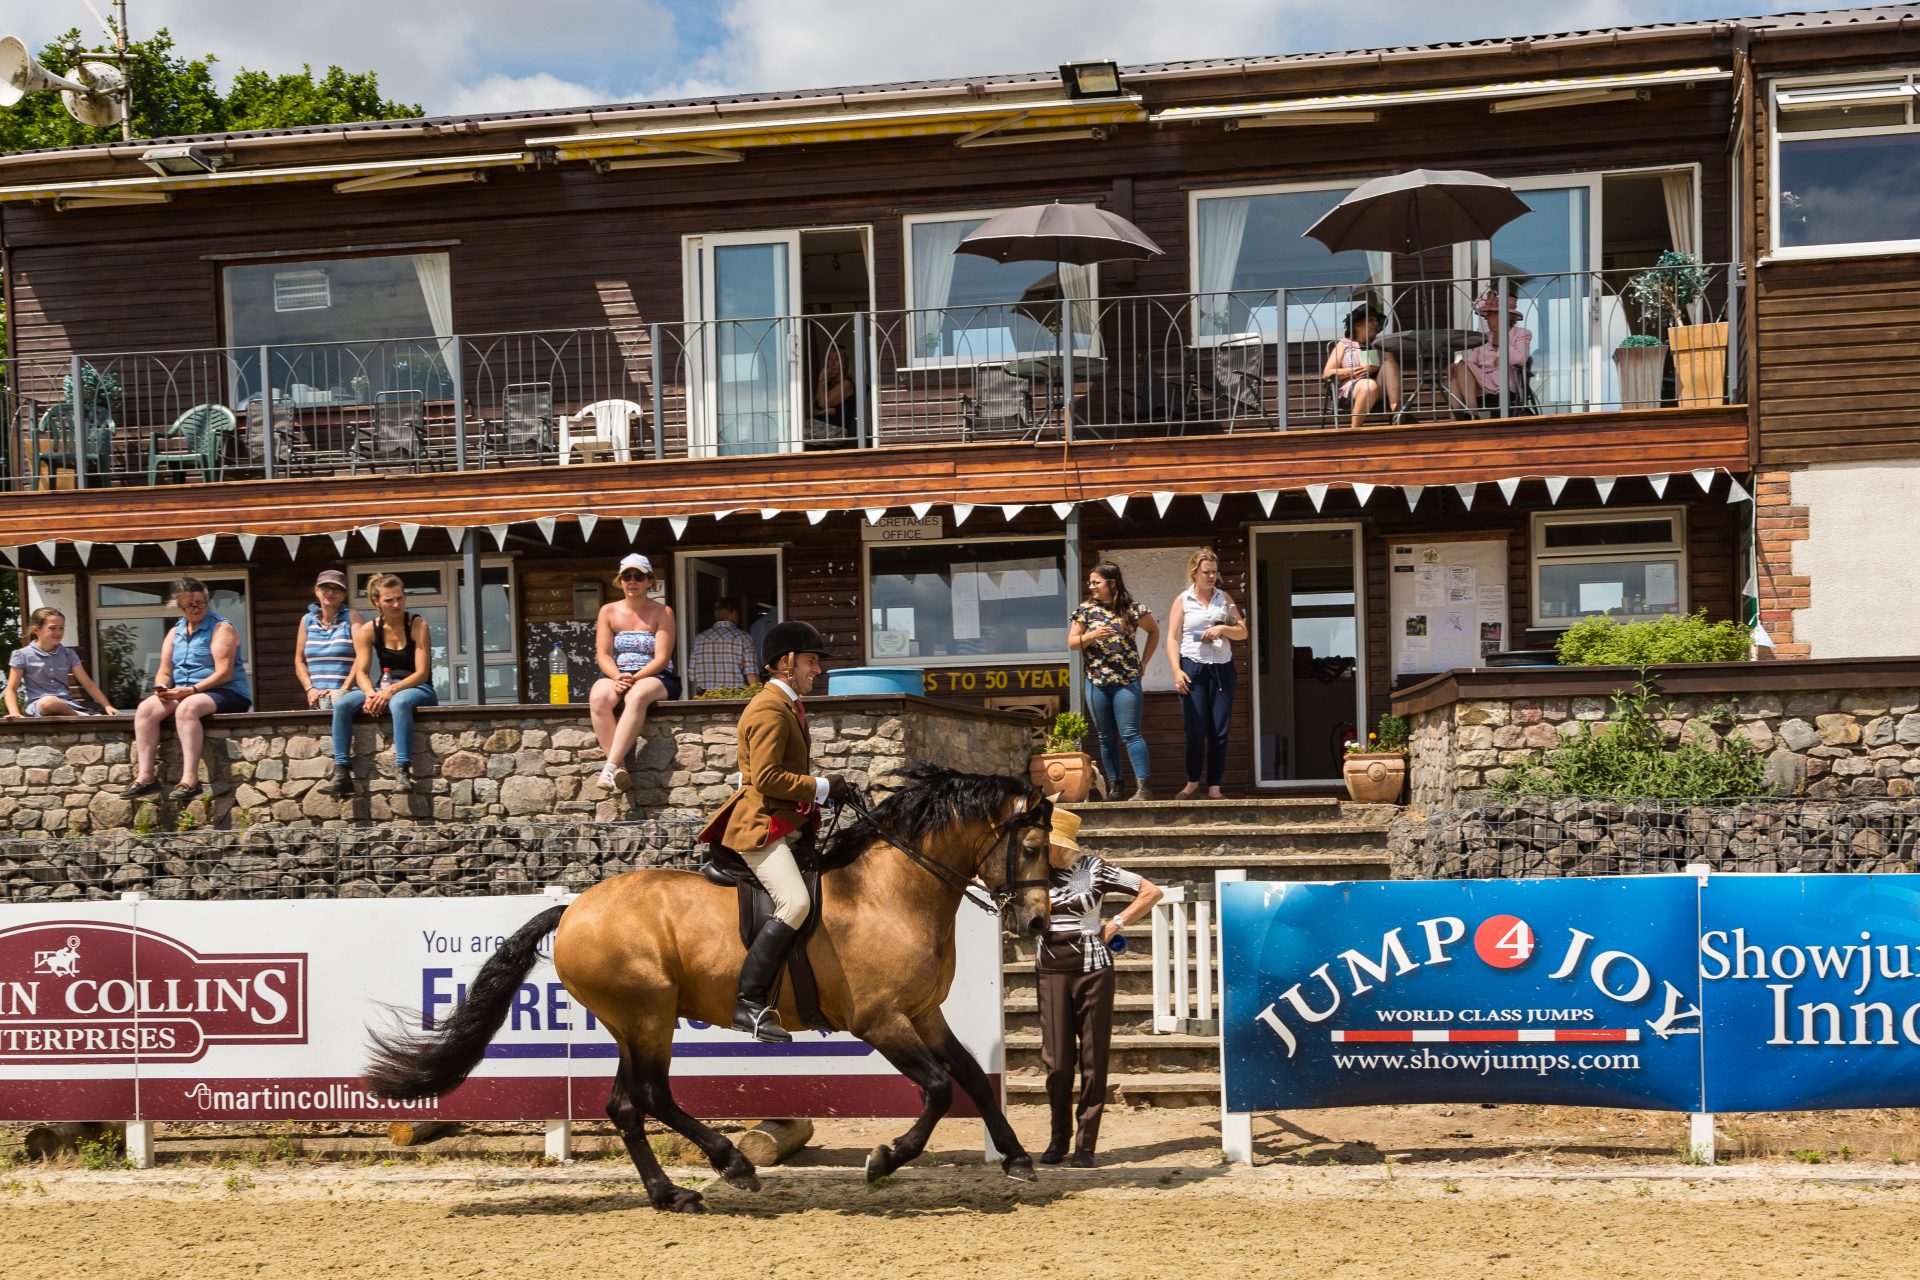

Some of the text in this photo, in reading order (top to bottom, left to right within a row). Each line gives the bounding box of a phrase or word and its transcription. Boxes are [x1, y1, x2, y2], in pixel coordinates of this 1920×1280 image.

[864, 517, 939, 528] SCRETARIES
[882, 530, 921, 540] OFFICE
[947, 672, 976, 691] TO
[985, 670, 1008, 689] 50
[422, 930, 461, 953] You
[64, 969, 288, 1024] COLLINS
[1254, 915, 1701, 1058] JUMP 4 JOY
[1375, 1008, 1595, 1023] WORLD CLASS JUMPS
[0, 1027, 176, 1051] TERPRISES
[1332, 1047, 1641, 1076] www.showjumps.com
